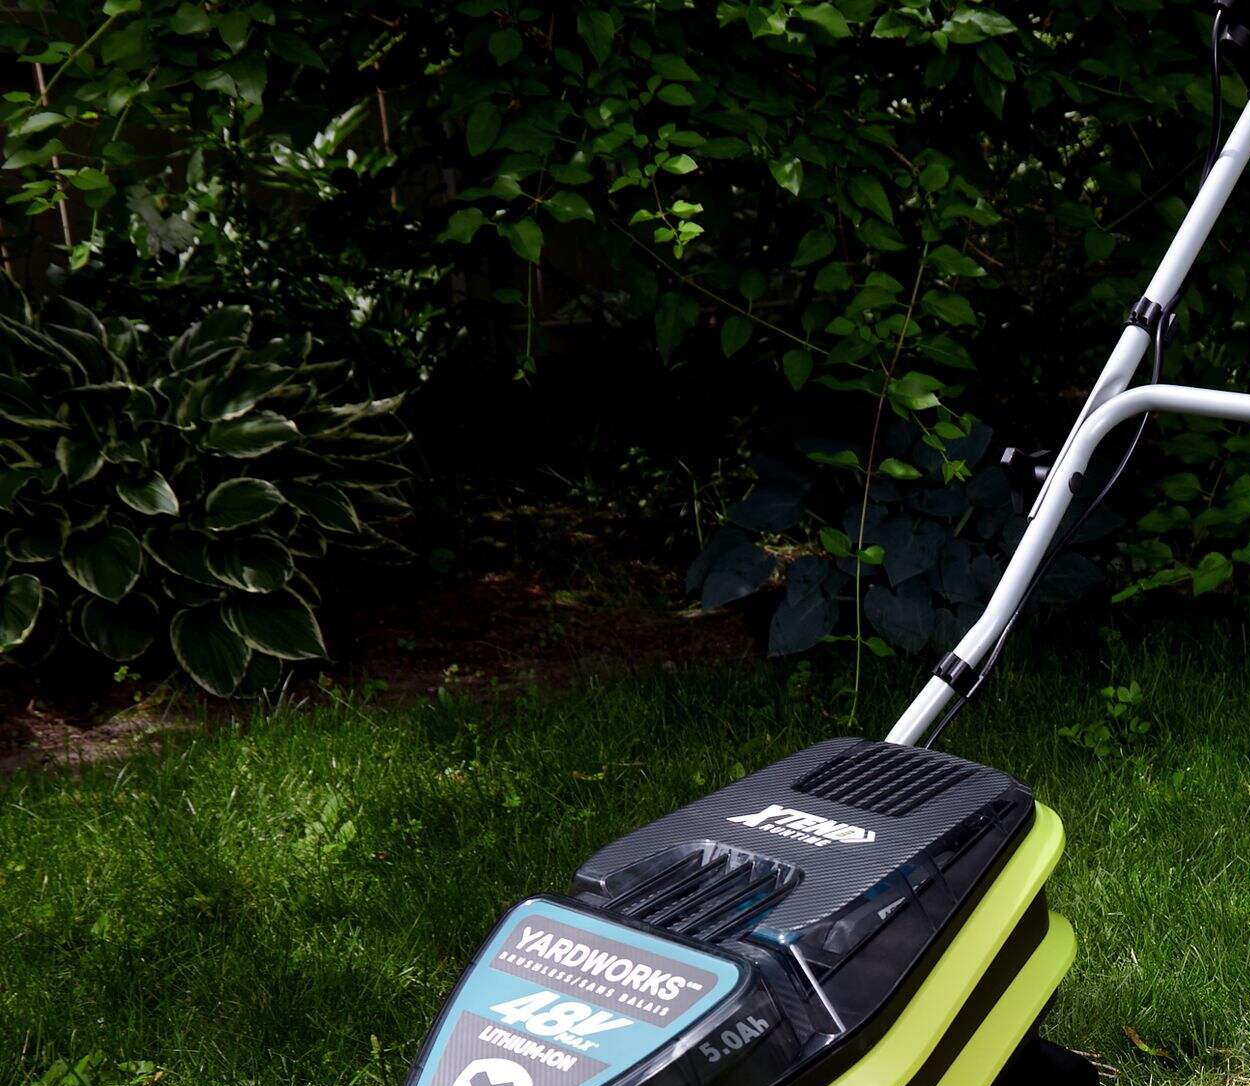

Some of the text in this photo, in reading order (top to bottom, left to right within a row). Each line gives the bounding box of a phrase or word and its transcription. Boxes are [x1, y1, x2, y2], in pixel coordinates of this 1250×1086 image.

[726, 804, 876, 844] XTEND
[758, 823, 832, 847] RUNTIME
[515, 926, 687, 1001] YARDWORKS
[490, 990, 635, 1037] 48V
[618, 993, 670, 1017] BALAIS
[478, 1025, 578, 1072] LITHIUM-ION
[553, 1031, 593, 1051] MAX
[699, 1014, 770, 1063] 5.0Ah
